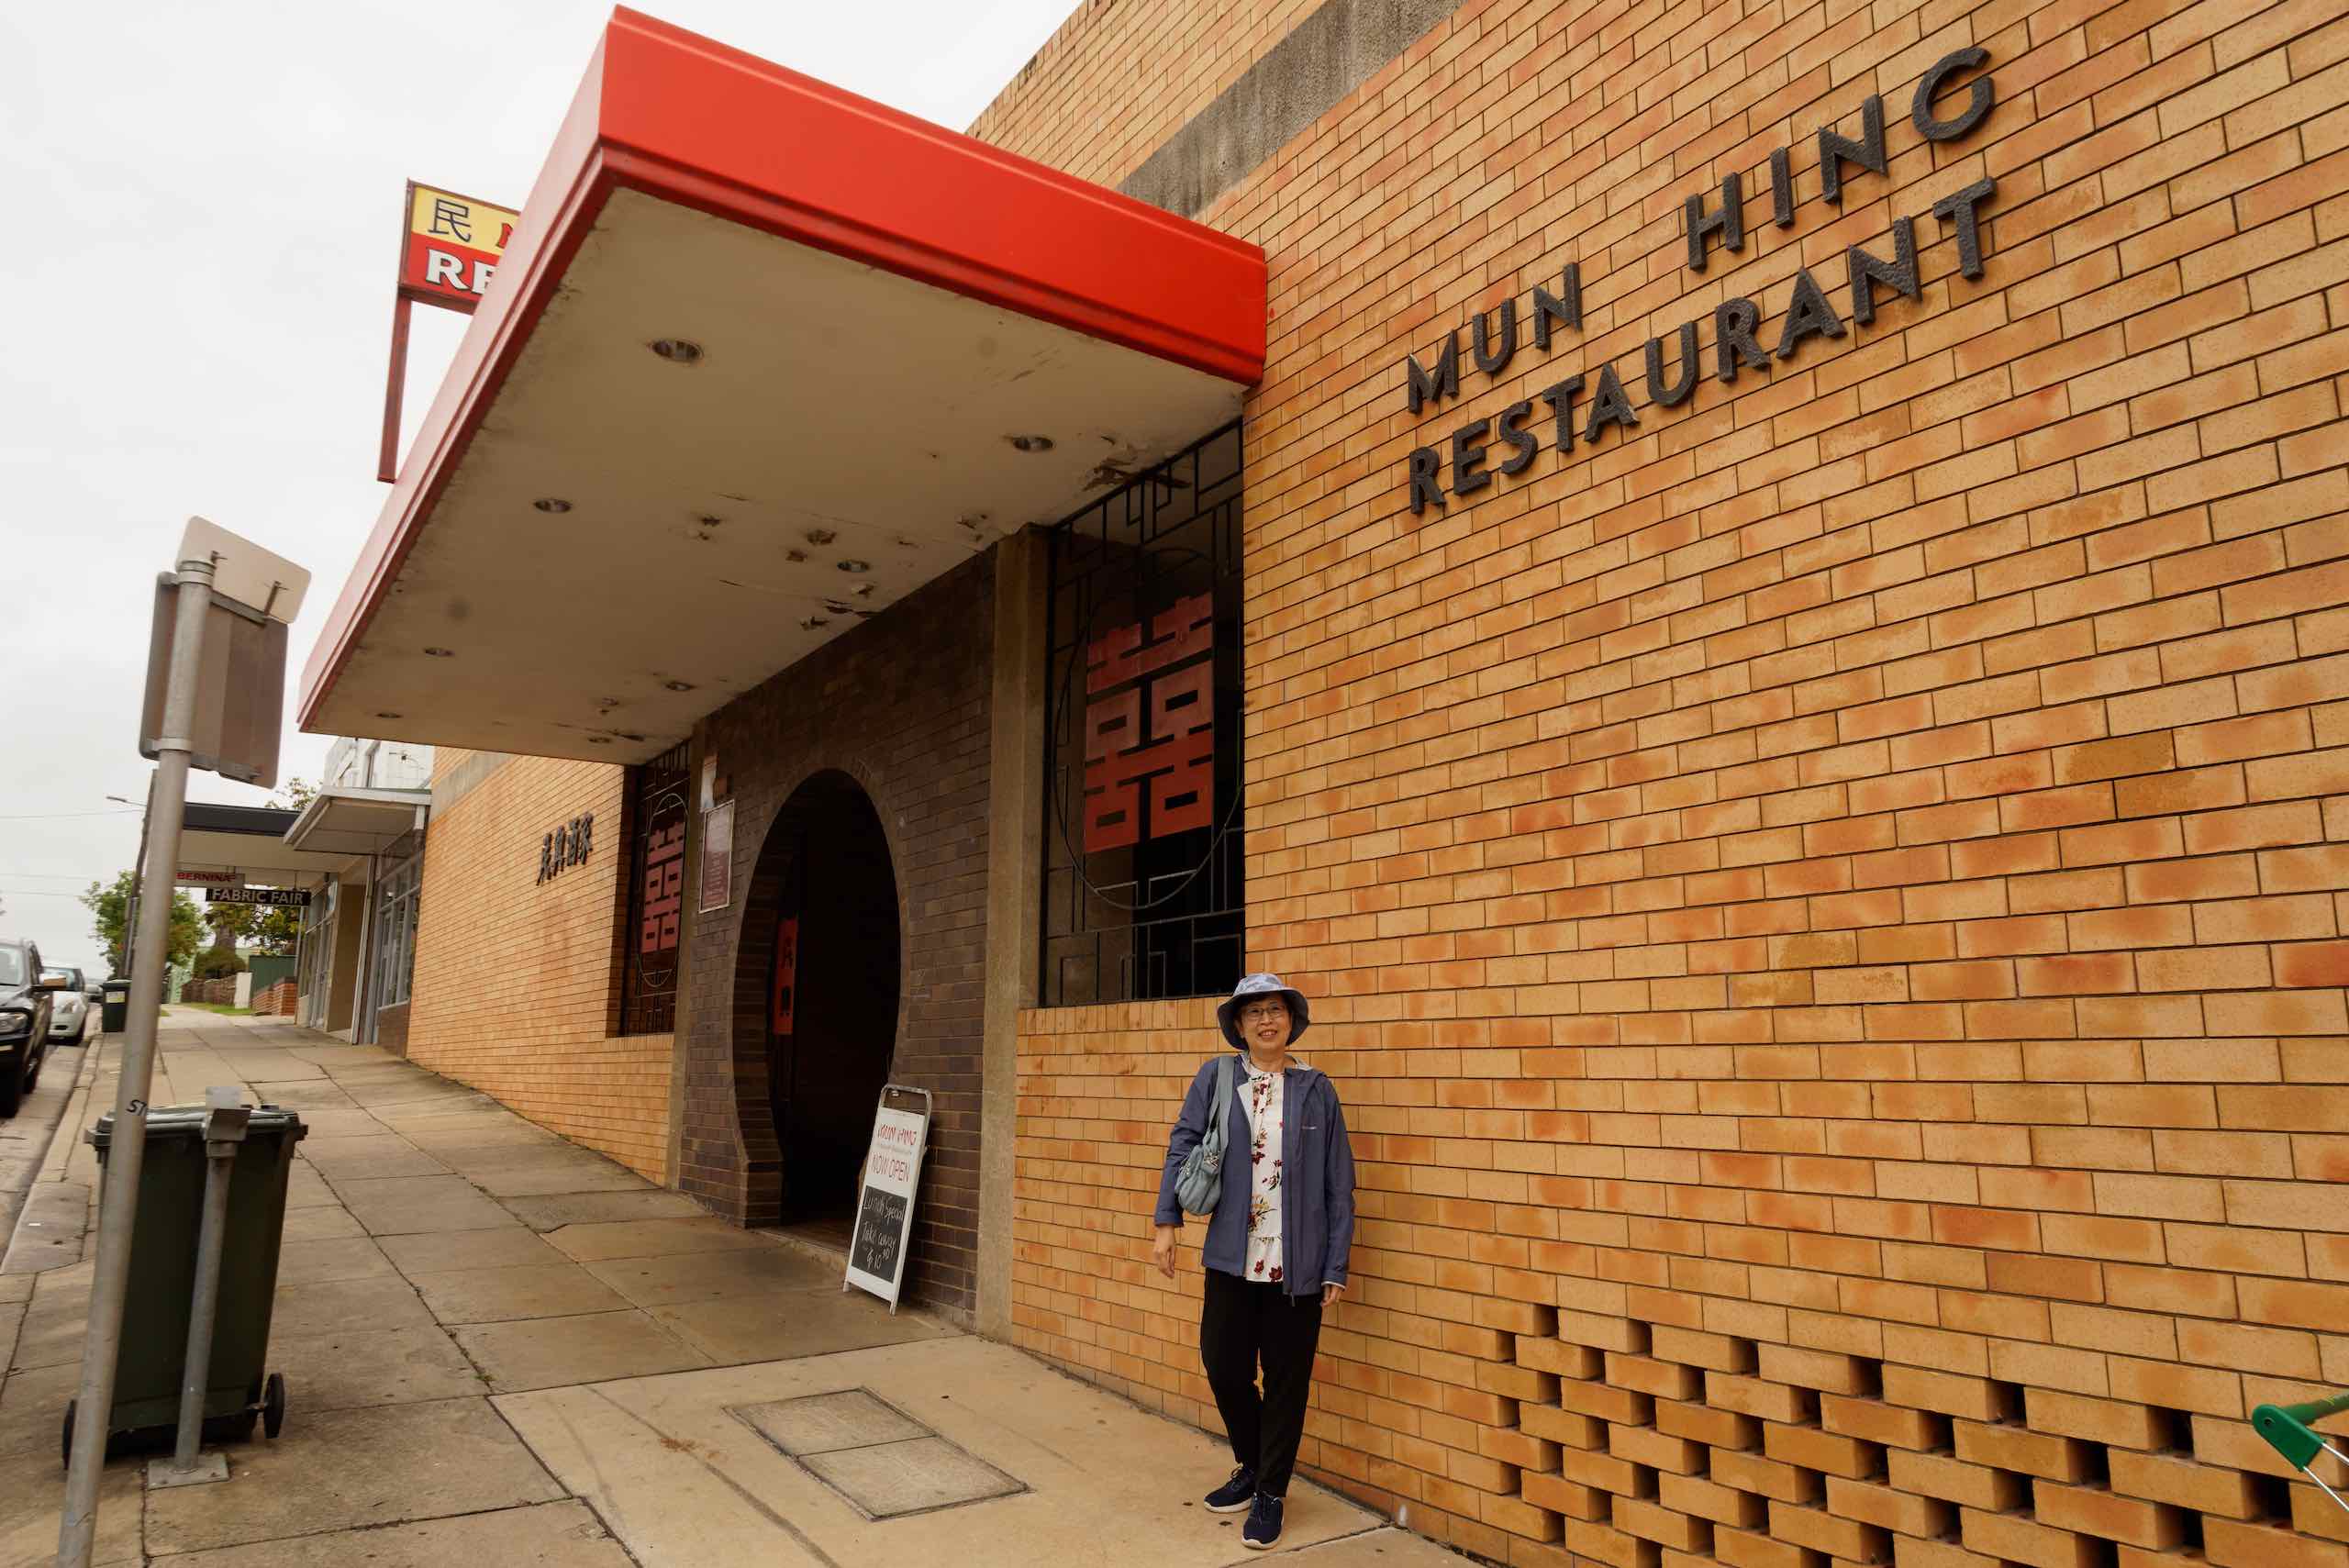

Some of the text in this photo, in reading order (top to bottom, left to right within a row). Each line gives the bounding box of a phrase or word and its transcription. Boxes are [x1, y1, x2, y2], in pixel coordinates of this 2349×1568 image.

[428, 197, 472, 242] 民
[1408, 46, 1994, 415] MUN HING
[1408, 176, 1998, 514] RESTAURANT
[212, 888, 304, 905] FABRIC FAIR
[877, 1123, 917, 1146] MUN HING
[871, 1152, 910, 1183] NOW OPEN
